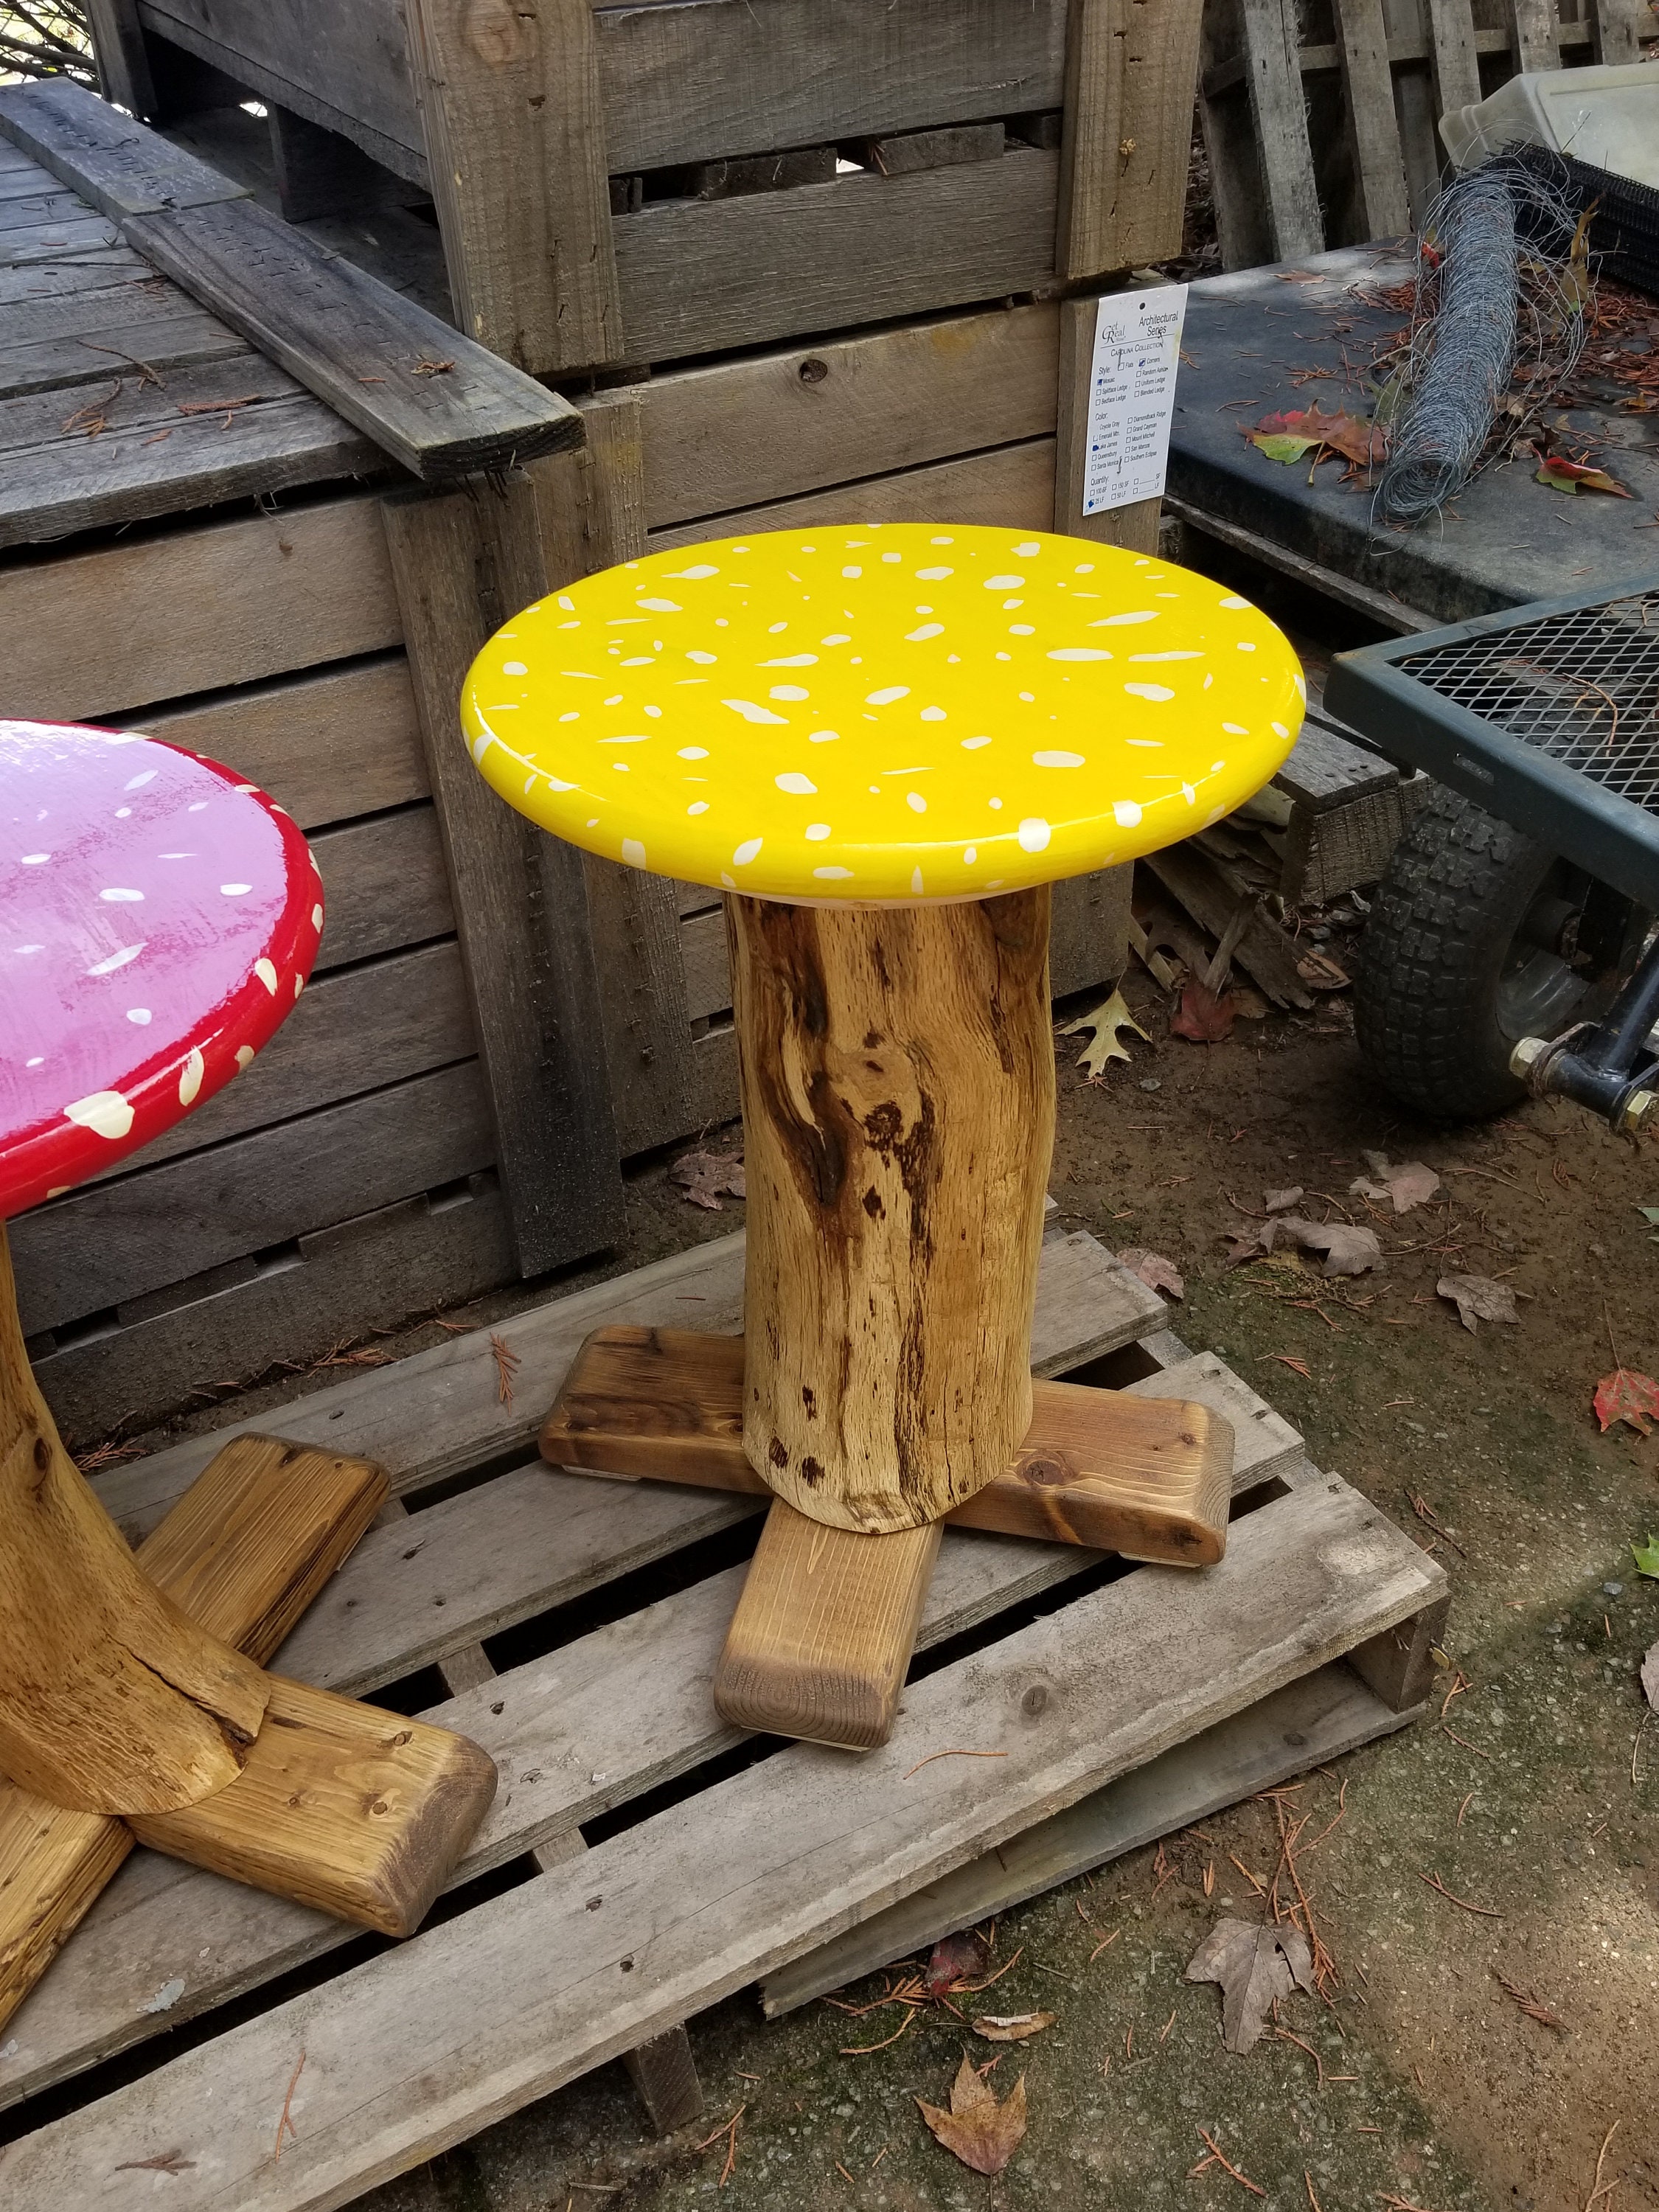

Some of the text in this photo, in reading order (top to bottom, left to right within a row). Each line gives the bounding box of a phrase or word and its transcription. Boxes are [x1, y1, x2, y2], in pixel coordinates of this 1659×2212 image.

[1139, 311, 1178, 327] Architectural
[1147, 324, 1167, 337] Series
[1135, 341, 1164, 352] COLLECTION
[1099, 366, 1111, 376] Style:
[1155, 376, 1166, 384] Ledge
[1116, 383, 1128, 392] Ledge
[1140, 386, 1165, 397] Blended Ledge
[1116, 394, 1127, 403] Ledge
[1095, 412, 1108, 421] Color:
[1133, 413, 1155, 422] Diamondback
[1133, 422, 1158, 433] Grand Cayman
[1099, 431, 1113, 440] Emerald
